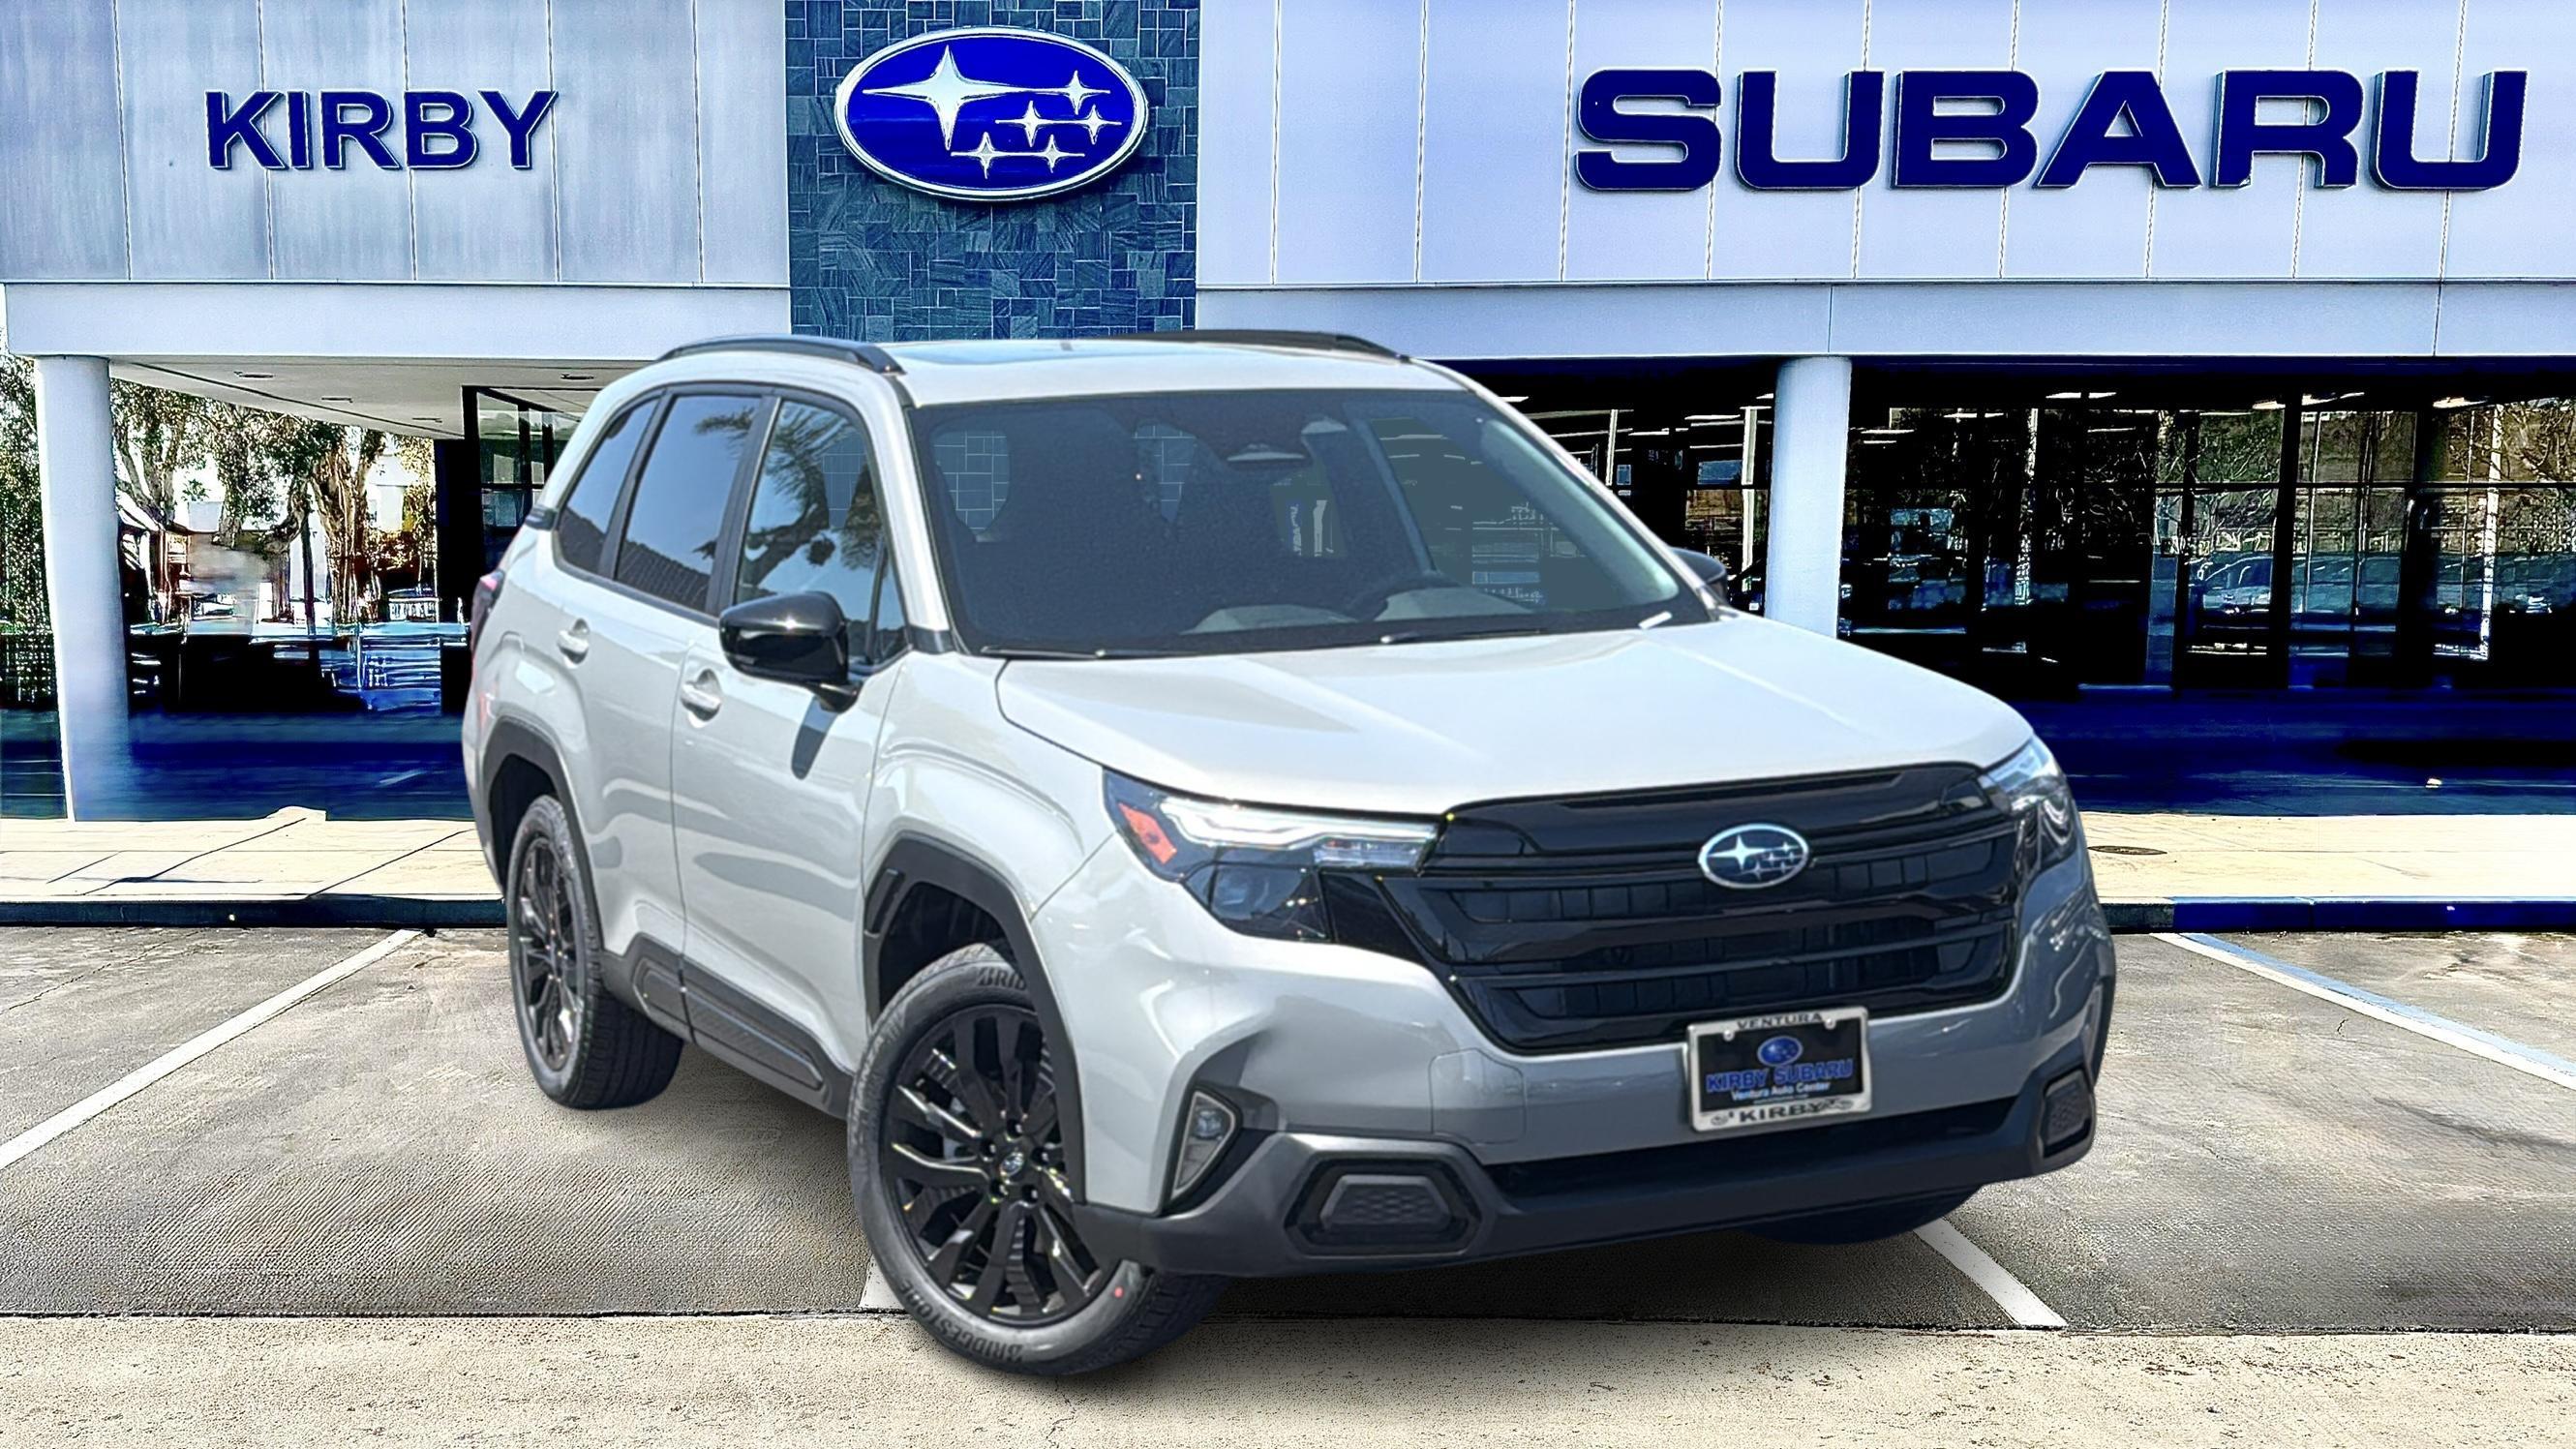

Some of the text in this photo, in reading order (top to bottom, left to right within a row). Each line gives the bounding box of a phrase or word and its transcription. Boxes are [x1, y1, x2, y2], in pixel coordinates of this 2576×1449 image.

[204, 90, 560, 170] KIRBY
[1574, 68, 2529, 191] SUBARU
[978, 966, 1026, 991] BRID
[1737, 1012, 1824, 1029] VENTURA
[1707, 1060, 1853, 1093] KIRBY SUBARU
[1731, 1089, 1770, 1102] Ventura
[1771, 1085, 1794, 1096] Auto
[1796, 1082, 1831, 1093] Center
[1740, 1102, 1822, 1122] KIRBY
